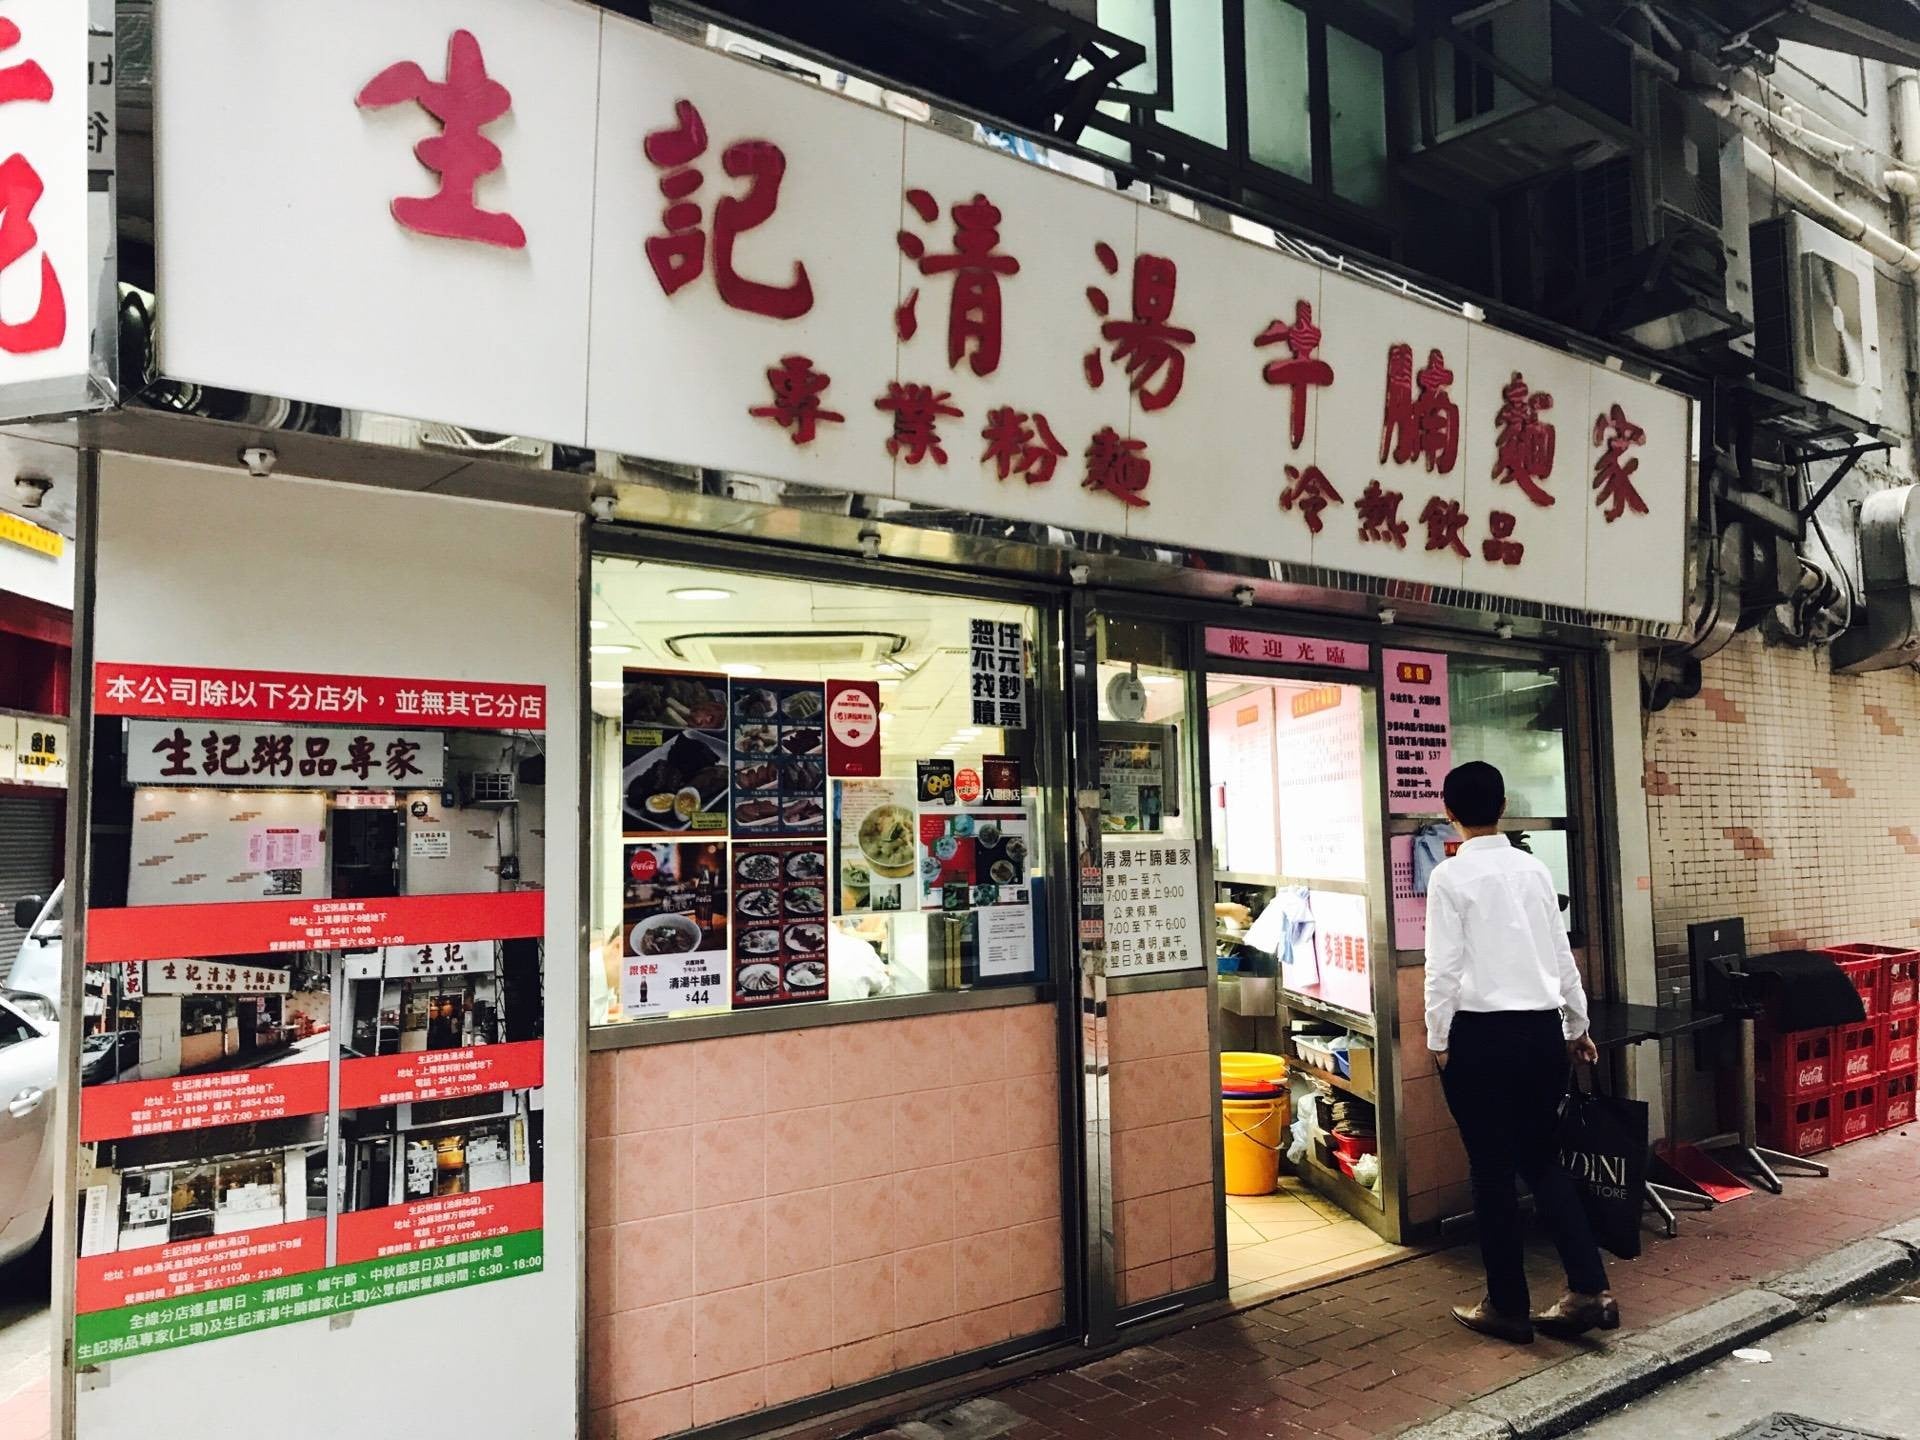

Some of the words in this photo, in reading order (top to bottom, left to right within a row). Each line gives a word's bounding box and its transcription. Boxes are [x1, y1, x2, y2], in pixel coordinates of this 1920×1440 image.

[354, 28, 1650, 524] 生記清湯牛腩麵家
[749, 355, 1152, 508] 專業粉麵
[1278, 463, 1525, 567] 冷熱飲品
[1228, 634, 1346, 664] 歡迎光臨
[105, 675, 542, 719] 本公司除以下分店外，並無其它分店
[151, 727, 424, 781] 生記粥品專家
[417, 943, 464, 965] 生記
[685, 989, 709, 1004] $44
[512, 1255, 542, 1270] 18:00
